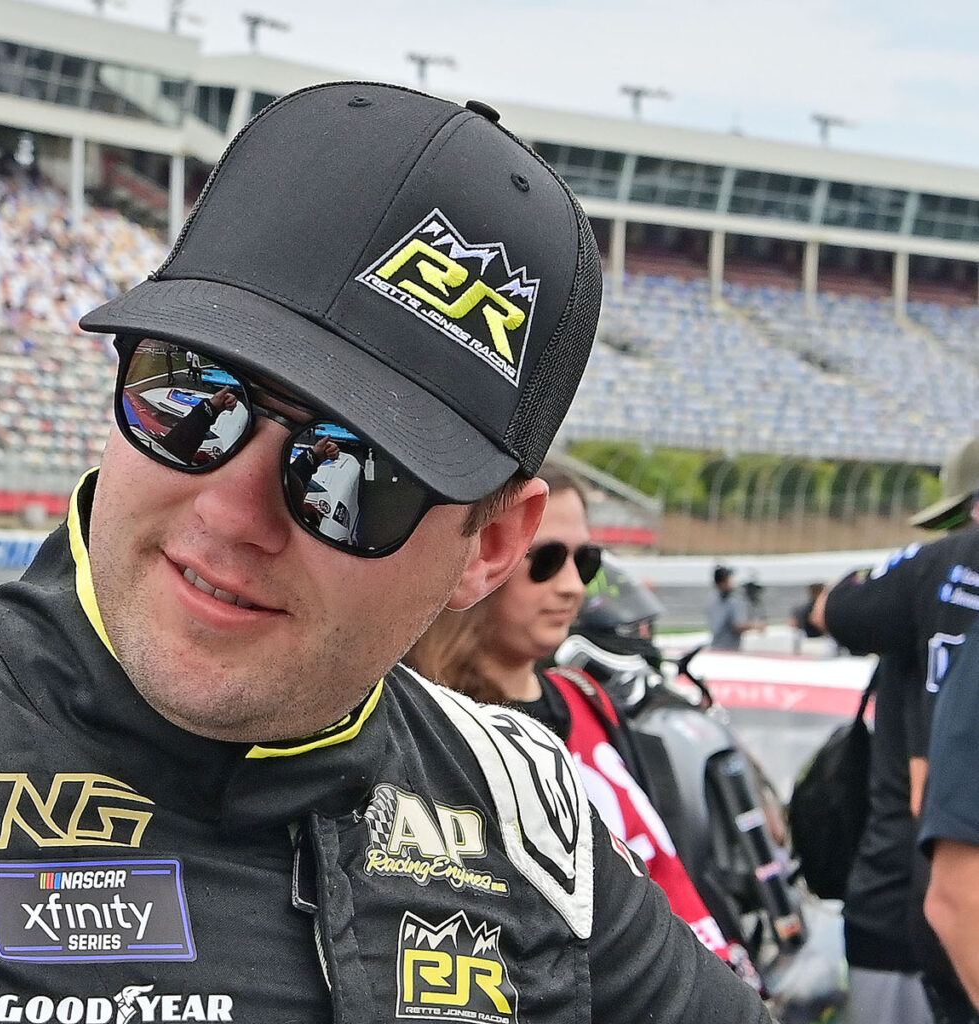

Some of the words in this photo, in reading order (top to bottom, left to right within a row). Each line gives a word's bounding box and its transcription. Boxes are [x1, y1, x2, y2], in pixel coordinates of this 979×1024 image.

[365, 274, 422, 310] RETTE
[421, 309, 472, 342] JONES
[470, 339, 517, 378] RACING
[388, 790, 486, 866] AP
[60, 870, 127, 889] NASCAR
[21, 893, 153, 941] xfinity
[68, 934, 122, 950] SERIES
[405, 1006, 441, 1015] RETTE
[442, 1008, 477, 1019] JONES
[478, 1013, 510, 1024] RACING
